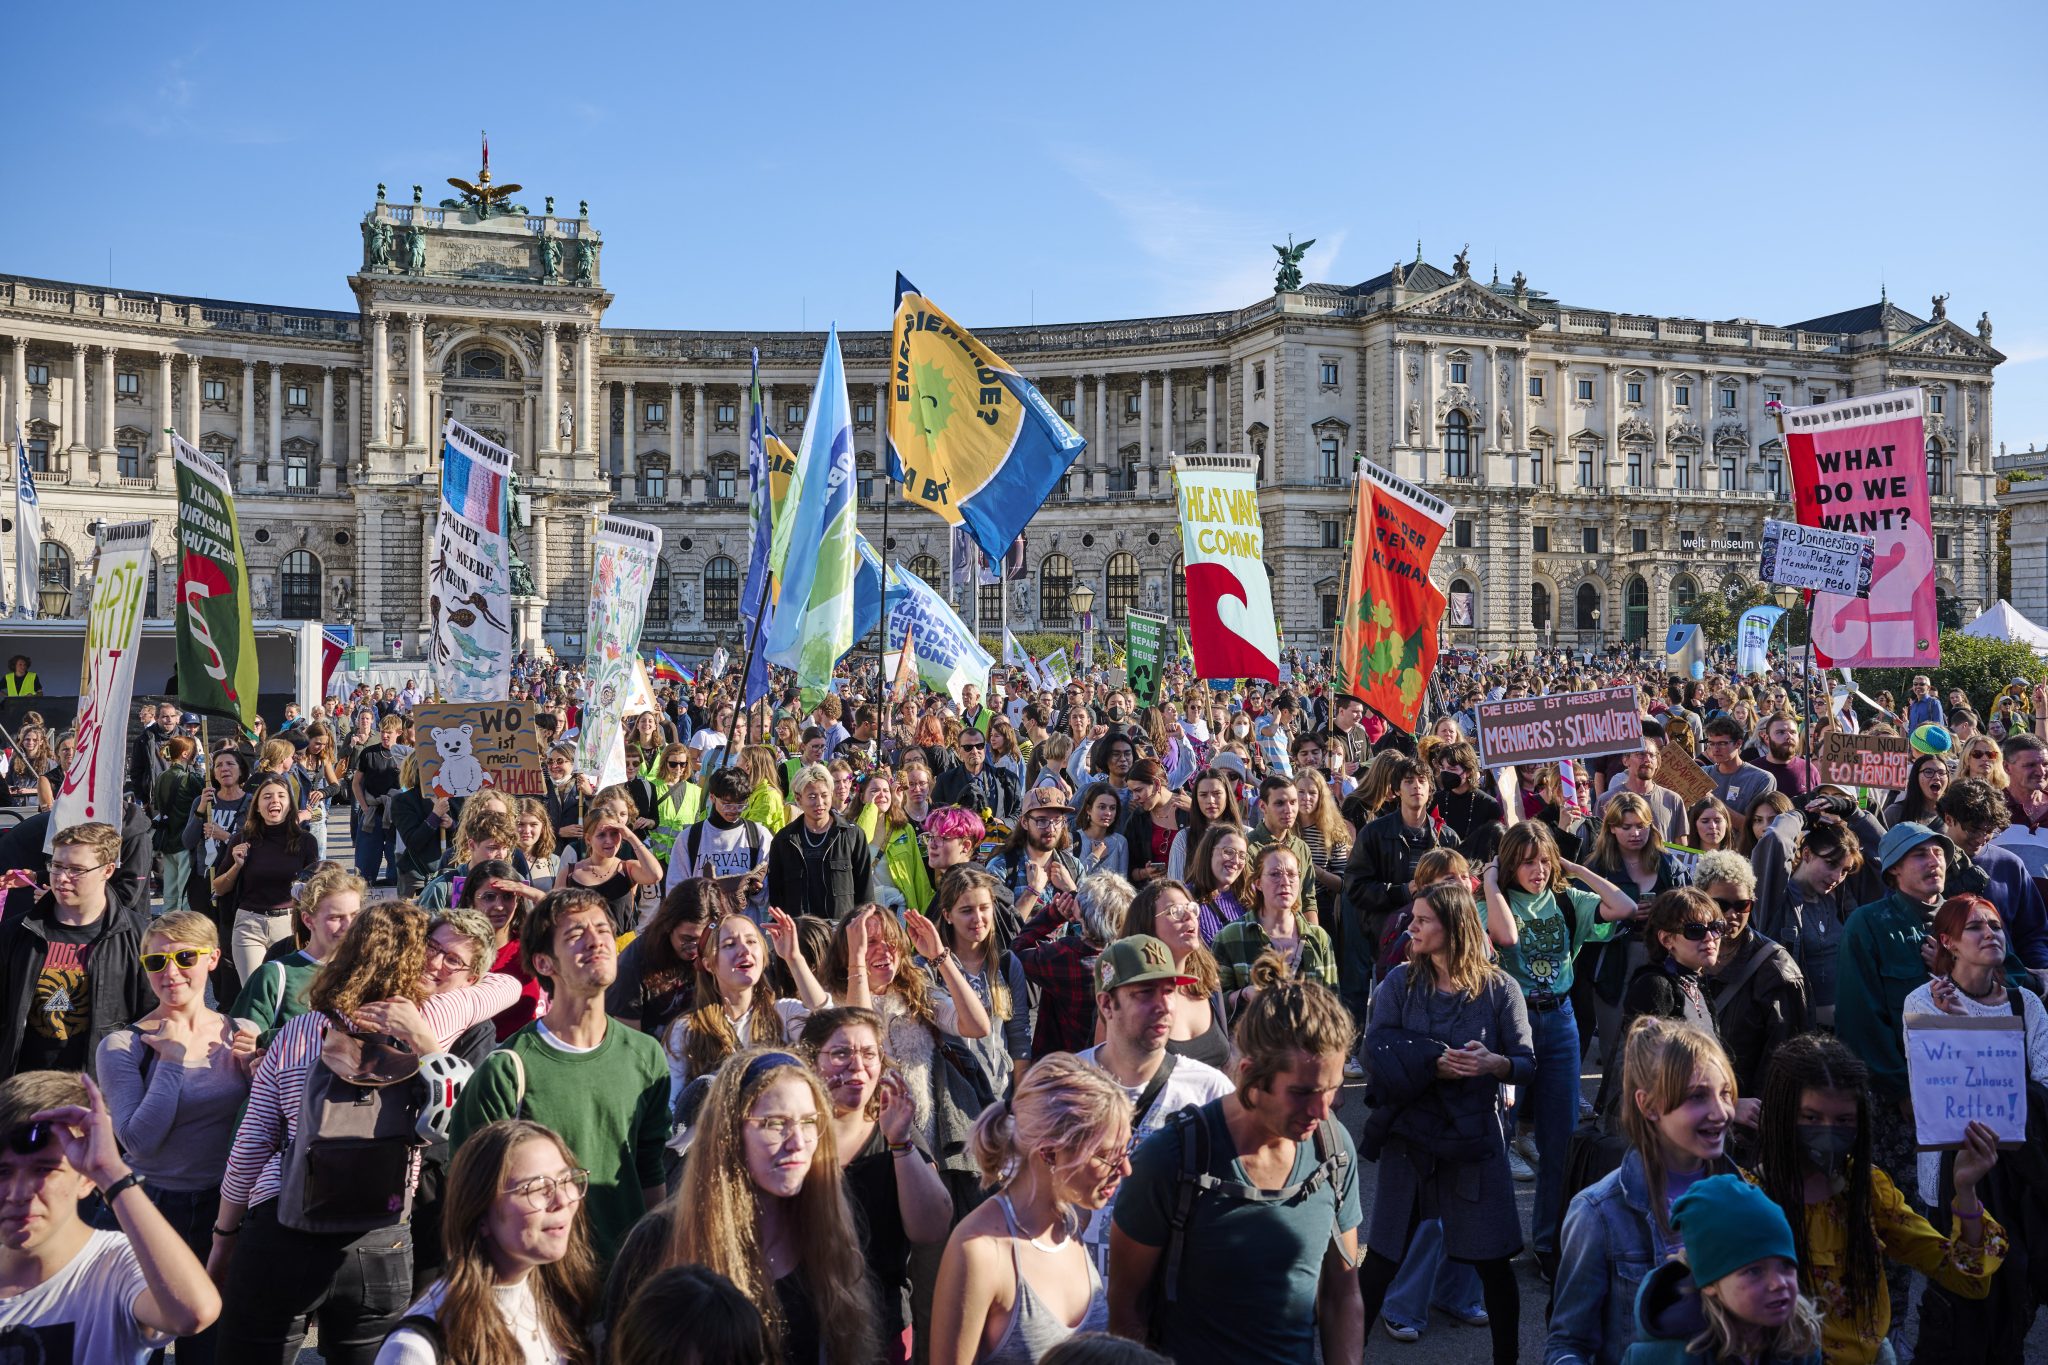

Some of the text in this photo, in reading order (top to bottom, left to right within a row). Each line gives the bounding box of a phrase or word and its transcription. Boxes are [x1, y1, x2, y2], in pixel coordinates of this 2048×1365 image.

[1816, 445, 1896, 474] WHAT
[190, 482, 223, 514] KLIMA
[1185, 486, 1225, 522] HEAT
[1814, 477, 1907, 505] DO WE
[1818, 507, 1911, 533] WANT?
[1683, 537, 1705, 548] welt
[1711, 540, 1754, 549] museum
[456, 549, 493, 581] MEERE
[1810, 550, 1832, 567] Platz
[890, 616, 960, 658] FÜR DAS
[894, 601, 967, 655] KÄMPFEN
[1131, 622, 1160, 636] RESIZE
[1131, 635, 1160, 650] REPAIR
[1132, 649, 1158, 664] REUSE
[1482, 689, 1632, 717] DIE ERDE IST HEISSER ALS
[480, 707, 522, 734] WO
[498, 734, 516, 749] ist
[487, 753, 518, 764] mein
[491, 769, 545, 795] ZUHAUSE
[1923, 1040, 1961, 1061] Wir
[1965, 1066, 2014, 1088] Zuhause
[1946, 1093, 2018, 1121] Retten!
